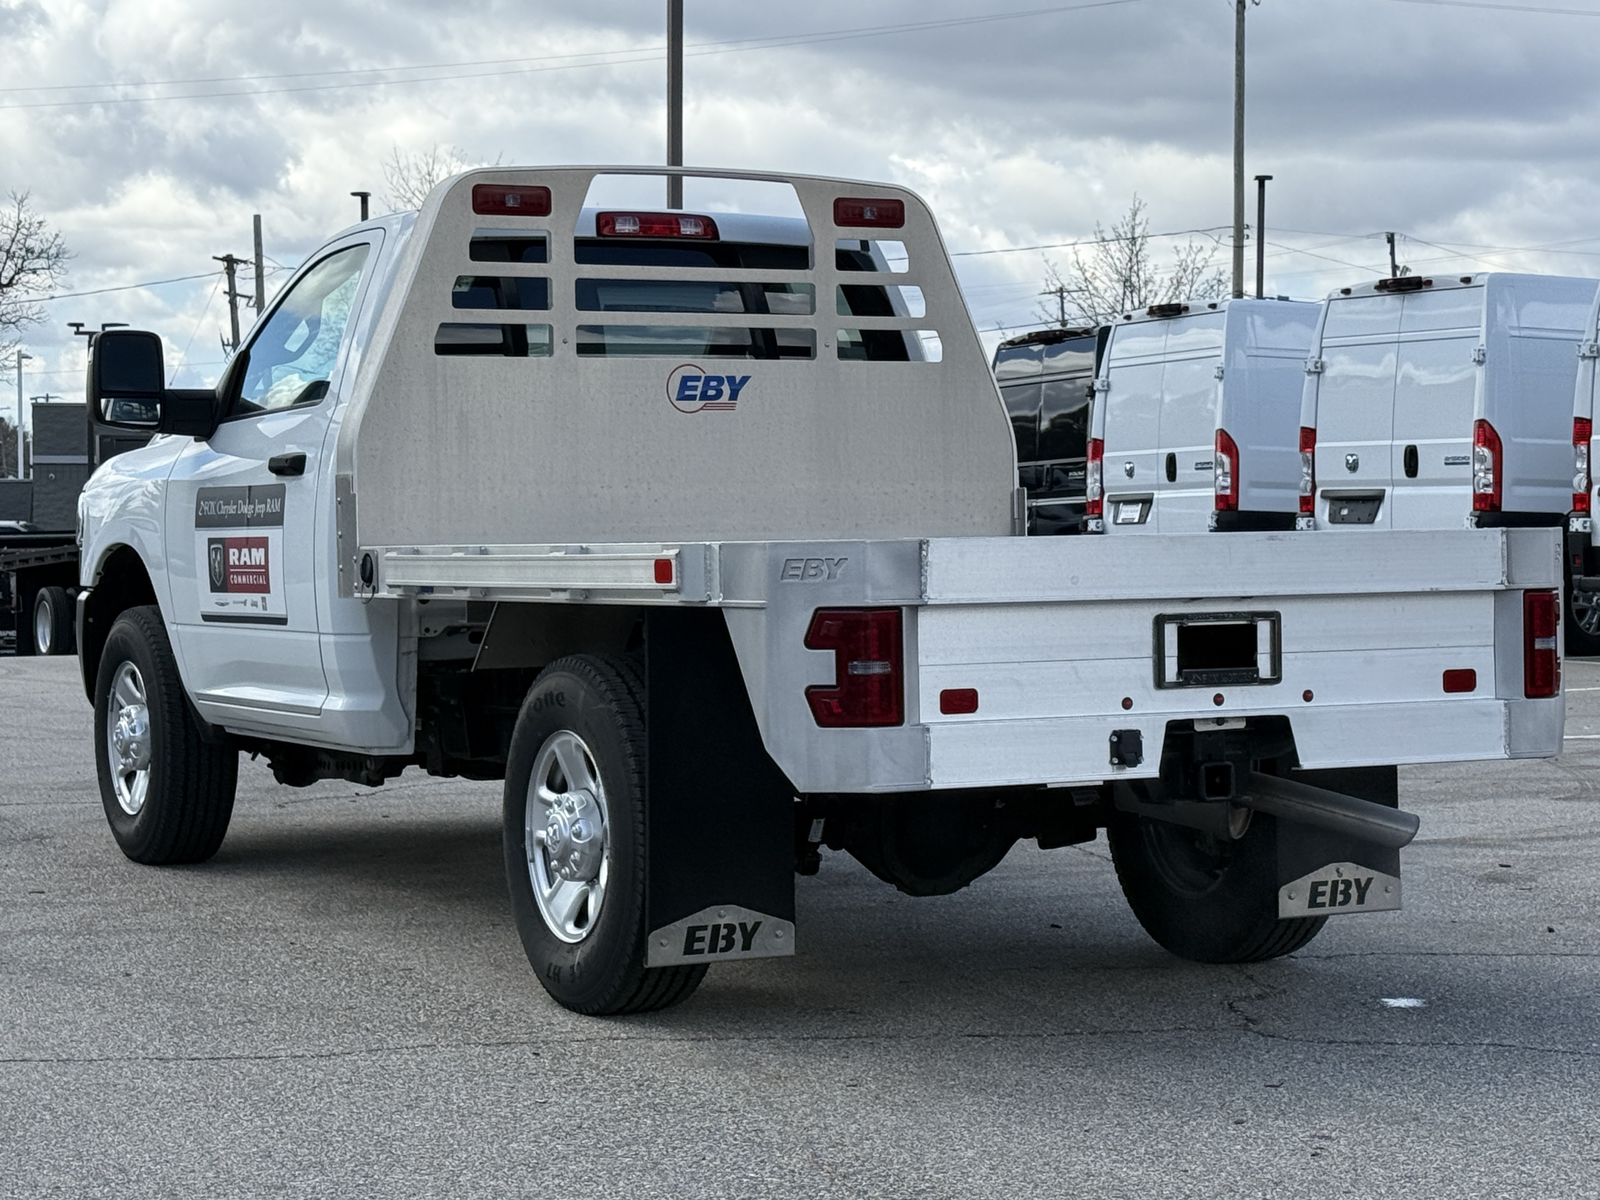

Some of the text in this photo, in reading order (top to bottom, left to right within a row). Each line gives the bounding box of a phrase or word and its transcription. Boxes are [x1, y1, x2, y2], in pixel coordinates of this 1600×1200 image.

[676, 375, 751, 401] EBY
[217, 500, 237, 518] Chrysler
[238, 499, 253, 518] Dodge
[254, 499, 265, 517] Jeep
[266, 498, 281, 513] RAM
[229, 548, 265, 565] RAM
[230, 574, 266, 584] COMMERCIAL
[780, 558, 848, 582] EBY
[1307, 878, 1374, 909] EBY
[683, 921, 762, 956] EBY
